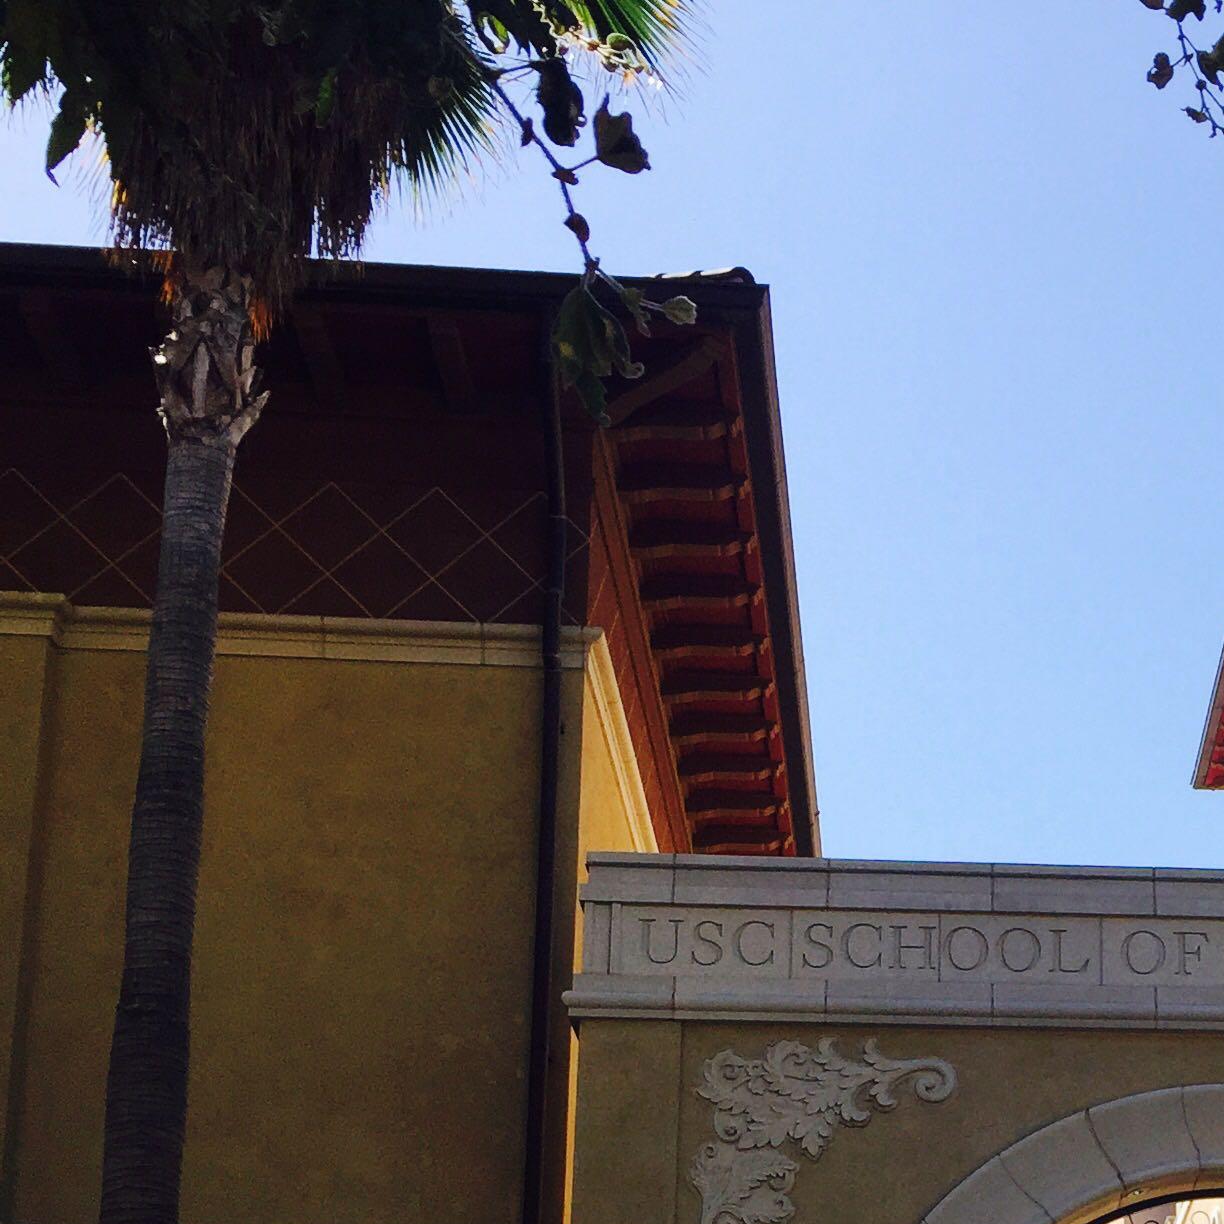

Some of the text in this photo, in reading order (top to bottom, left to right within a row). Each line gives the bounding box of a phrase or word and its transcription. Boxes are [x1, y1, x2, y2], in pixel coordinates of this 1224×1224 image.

[638, 918, 776, 967] USC
[801, 922, 1091, 974] SCHOOL
[1121, 929, 1210, 976] OF
